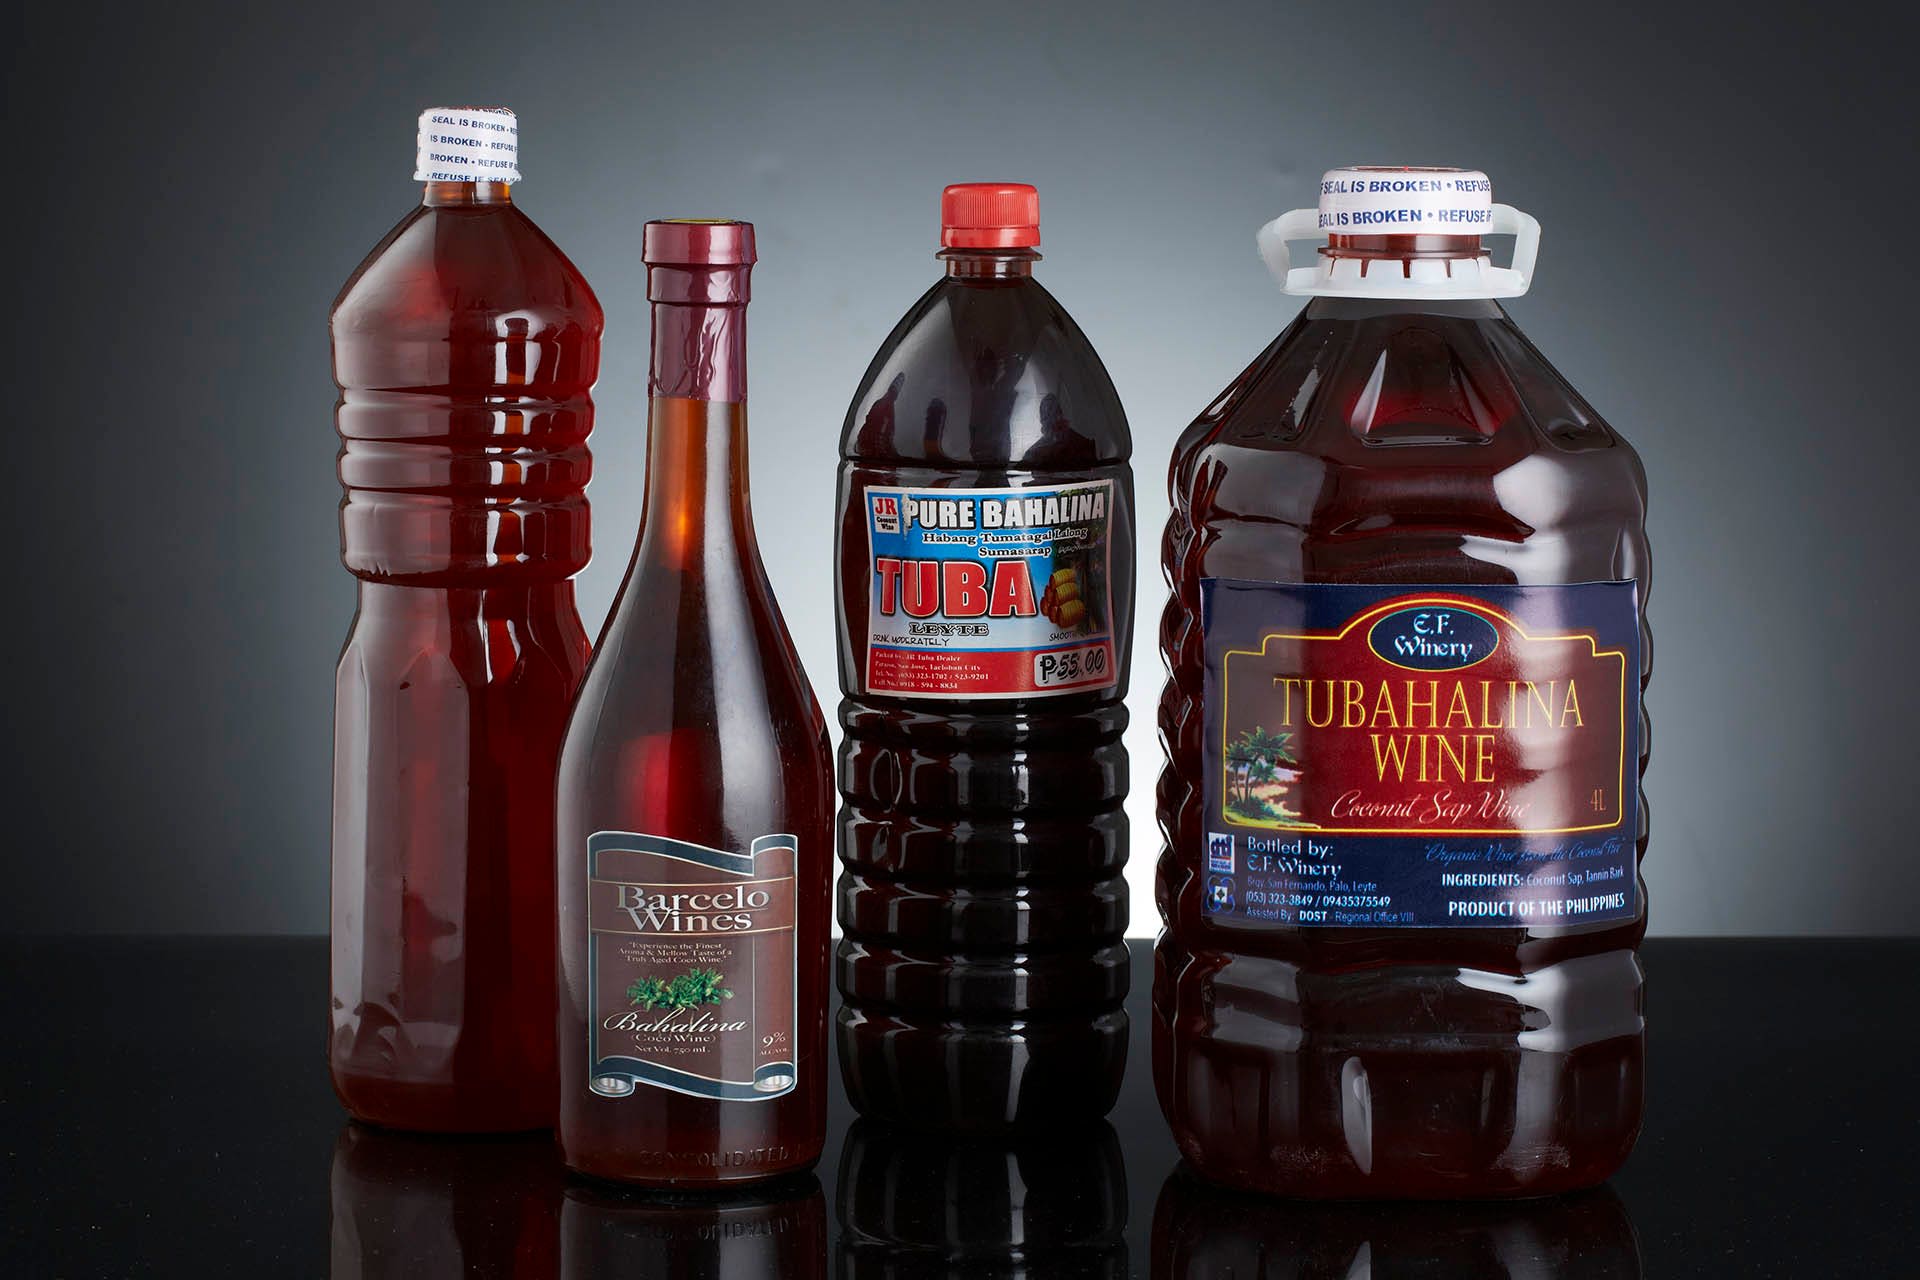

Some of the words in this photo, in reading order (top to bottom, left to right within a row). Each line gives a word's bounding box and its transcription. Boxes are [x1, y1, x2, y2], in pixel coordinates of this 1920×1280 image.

[432, 116, 456, 126] SEAL
[458, 118, 468, 127] IS
[472, 120, 506, 132] BROKEN
[430, 134, 438, 143] IS
[440, 136, 482, 148] BROKEN
[430, 153, 468, 164] BROKEN
[478, 158, 508, 169] REFUSE
[432, 172, 470, 182] REFUSE
[1324, 179, 1348, 194] SEAL
[1350, 180, 1364, 193] IS
[1369, 180, 1442, 193] BROKEN
[1456, 180, 1490, 192] REFUSE
[1336, 213, 1348, 226] IS
[1352, 210, 1422, 224] BROKEN
[1438, 209, 1485, 222] REFUSE
[876, 498, 897, 516] JR
[905, 499, 976, 529] PURE
[983, 492, 1105, 528] BAHALINA
[923, 533, 976, 546] Habang
[980, 530, 1052, 545] Tumatagal
[1055, 528, 1088, 539] Lalong
[978, 546, 1052, 558] Sumasarap
[877, 557, 1038, 618] TUBA
[909, 622, 990, 636] LEYTE
[1414, 614, 1454, 635] E.F.
[891, 635, 950, 647] MODERATELY
[1394, 635, 1472, 662] Winery
[1273, 678, 1584, 729] TUBAHALINA
[1370, 734, 1496, 783] WINE
[1330, 790, 1421, 818] Coconut
[1419, 789, 1472, 824] Sap
[1476, 790, 1532, 818] Wine
[1590, 789, 1606, 811] 4L
[1248, 836, 1301, 855] Bottled
[1308, 840, 1334, 860] by:
[1518, 847, 1547, 864] from
[1550, 844, 1564, 861] the
[1247, 854, 1276, 873] E.F.
[1278, 857, 1342, 880] Winery
[1442, 874, 1524, 886] INGREDIENTS:
[1526, 874, 1565, 886] Coconut
[1568, 872, 1584, 886] Sap,
[1586, 868, 1610, 882] Tannin
[1610, 866, 1624, 880] Bark
[1268, 878, 1284, 889] San
[1284, 880, 1326, 892] Fernando,
[1330, 882, 1350, 893] Palo,
[1352, 882, 1377, 894] Leyte
[618, 885, 770, 910] Barcelo
[1246, 892, 1267, 905] (053)
[1268, 894, 1312, 906] 323-3849
[1322, 896, 1391, 908] 09435375549
[1449, 900, 1515, 916] PRODUCT
[1518, 901, 1534, 916] OF
[1539, 899, 1564, 916] THE
[1566, 892, 1625, 914] PHILIPPINES
[628, 906, 753, 932] Wines
[1246, 907, 1278, 920] Assisted
[1280, 910, 1294, 920] By:
[1300, 911, 1328, 920] DOST
[1336, 912, 1371, 924] Regional
[1374, 912, 1398, 922] Office
[603, 1008, 748, 1034] Bahalina
[631, 1034, 671, 1042] (Coco
[674, 1034, 717, 1042] Wine)
[762, 1032, 786, 1048] 9%
